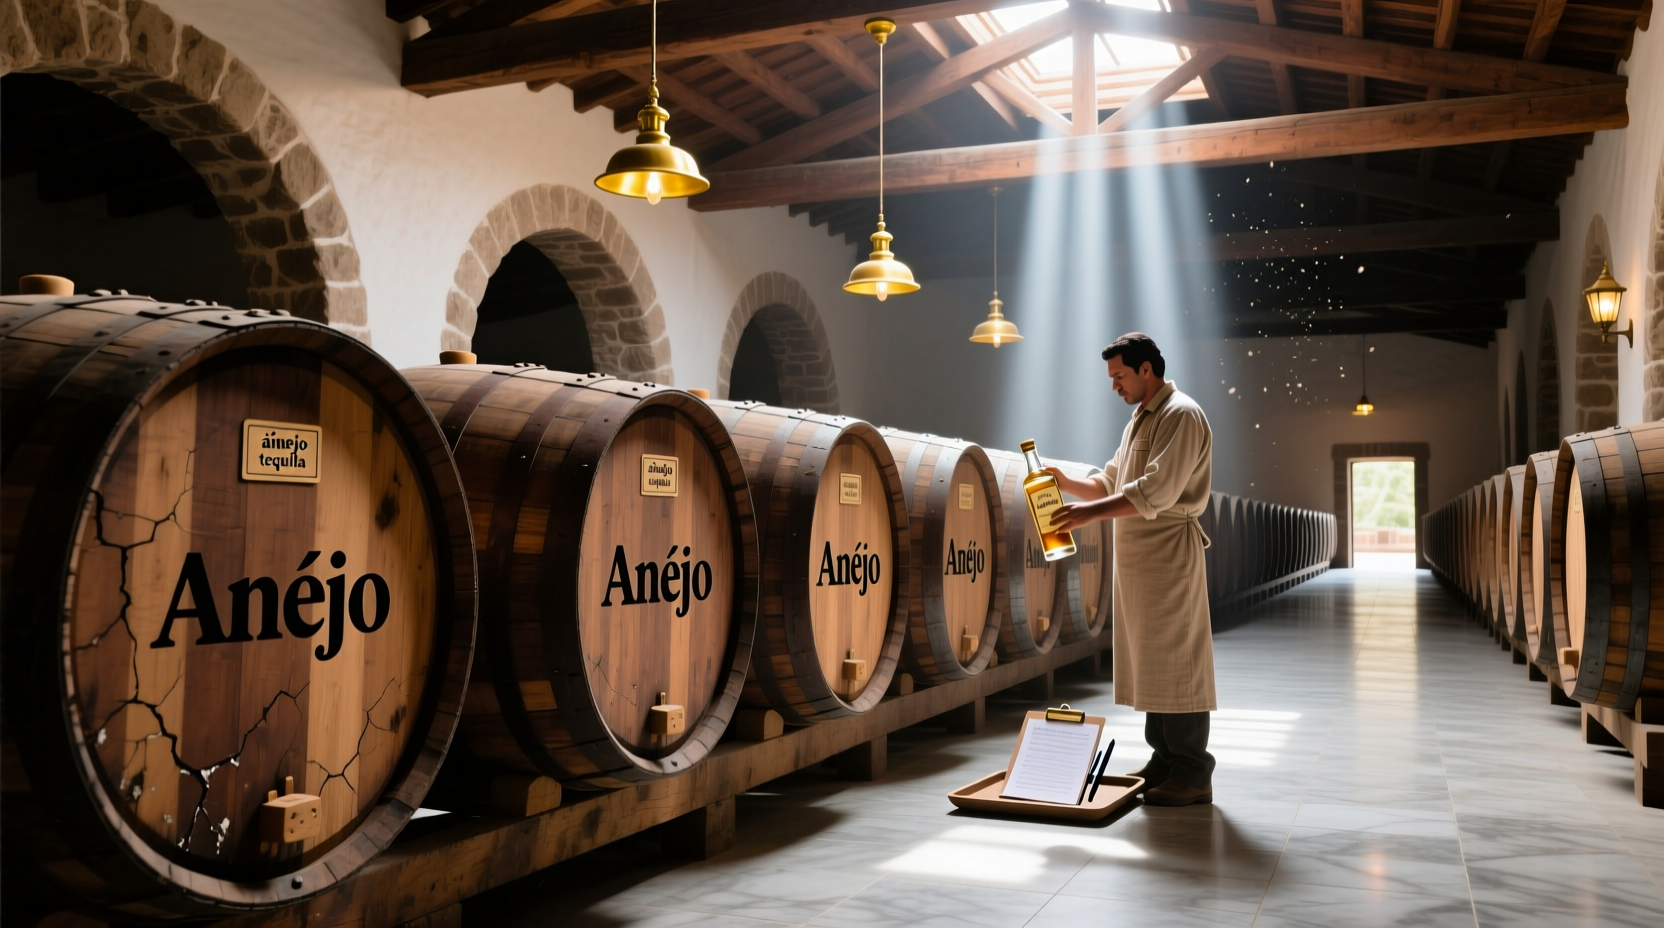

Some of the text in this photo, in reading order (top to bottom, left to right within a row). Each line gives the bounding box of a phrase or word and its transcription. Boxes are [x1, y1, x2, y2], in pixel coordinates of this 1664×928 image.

[601, 545, 713, 618] Anéjo
[816, 541, 881, 597] Anéjo
[944, 538, 985, 584] Anéjo
[150, 550, 391, 661] Anéjo
